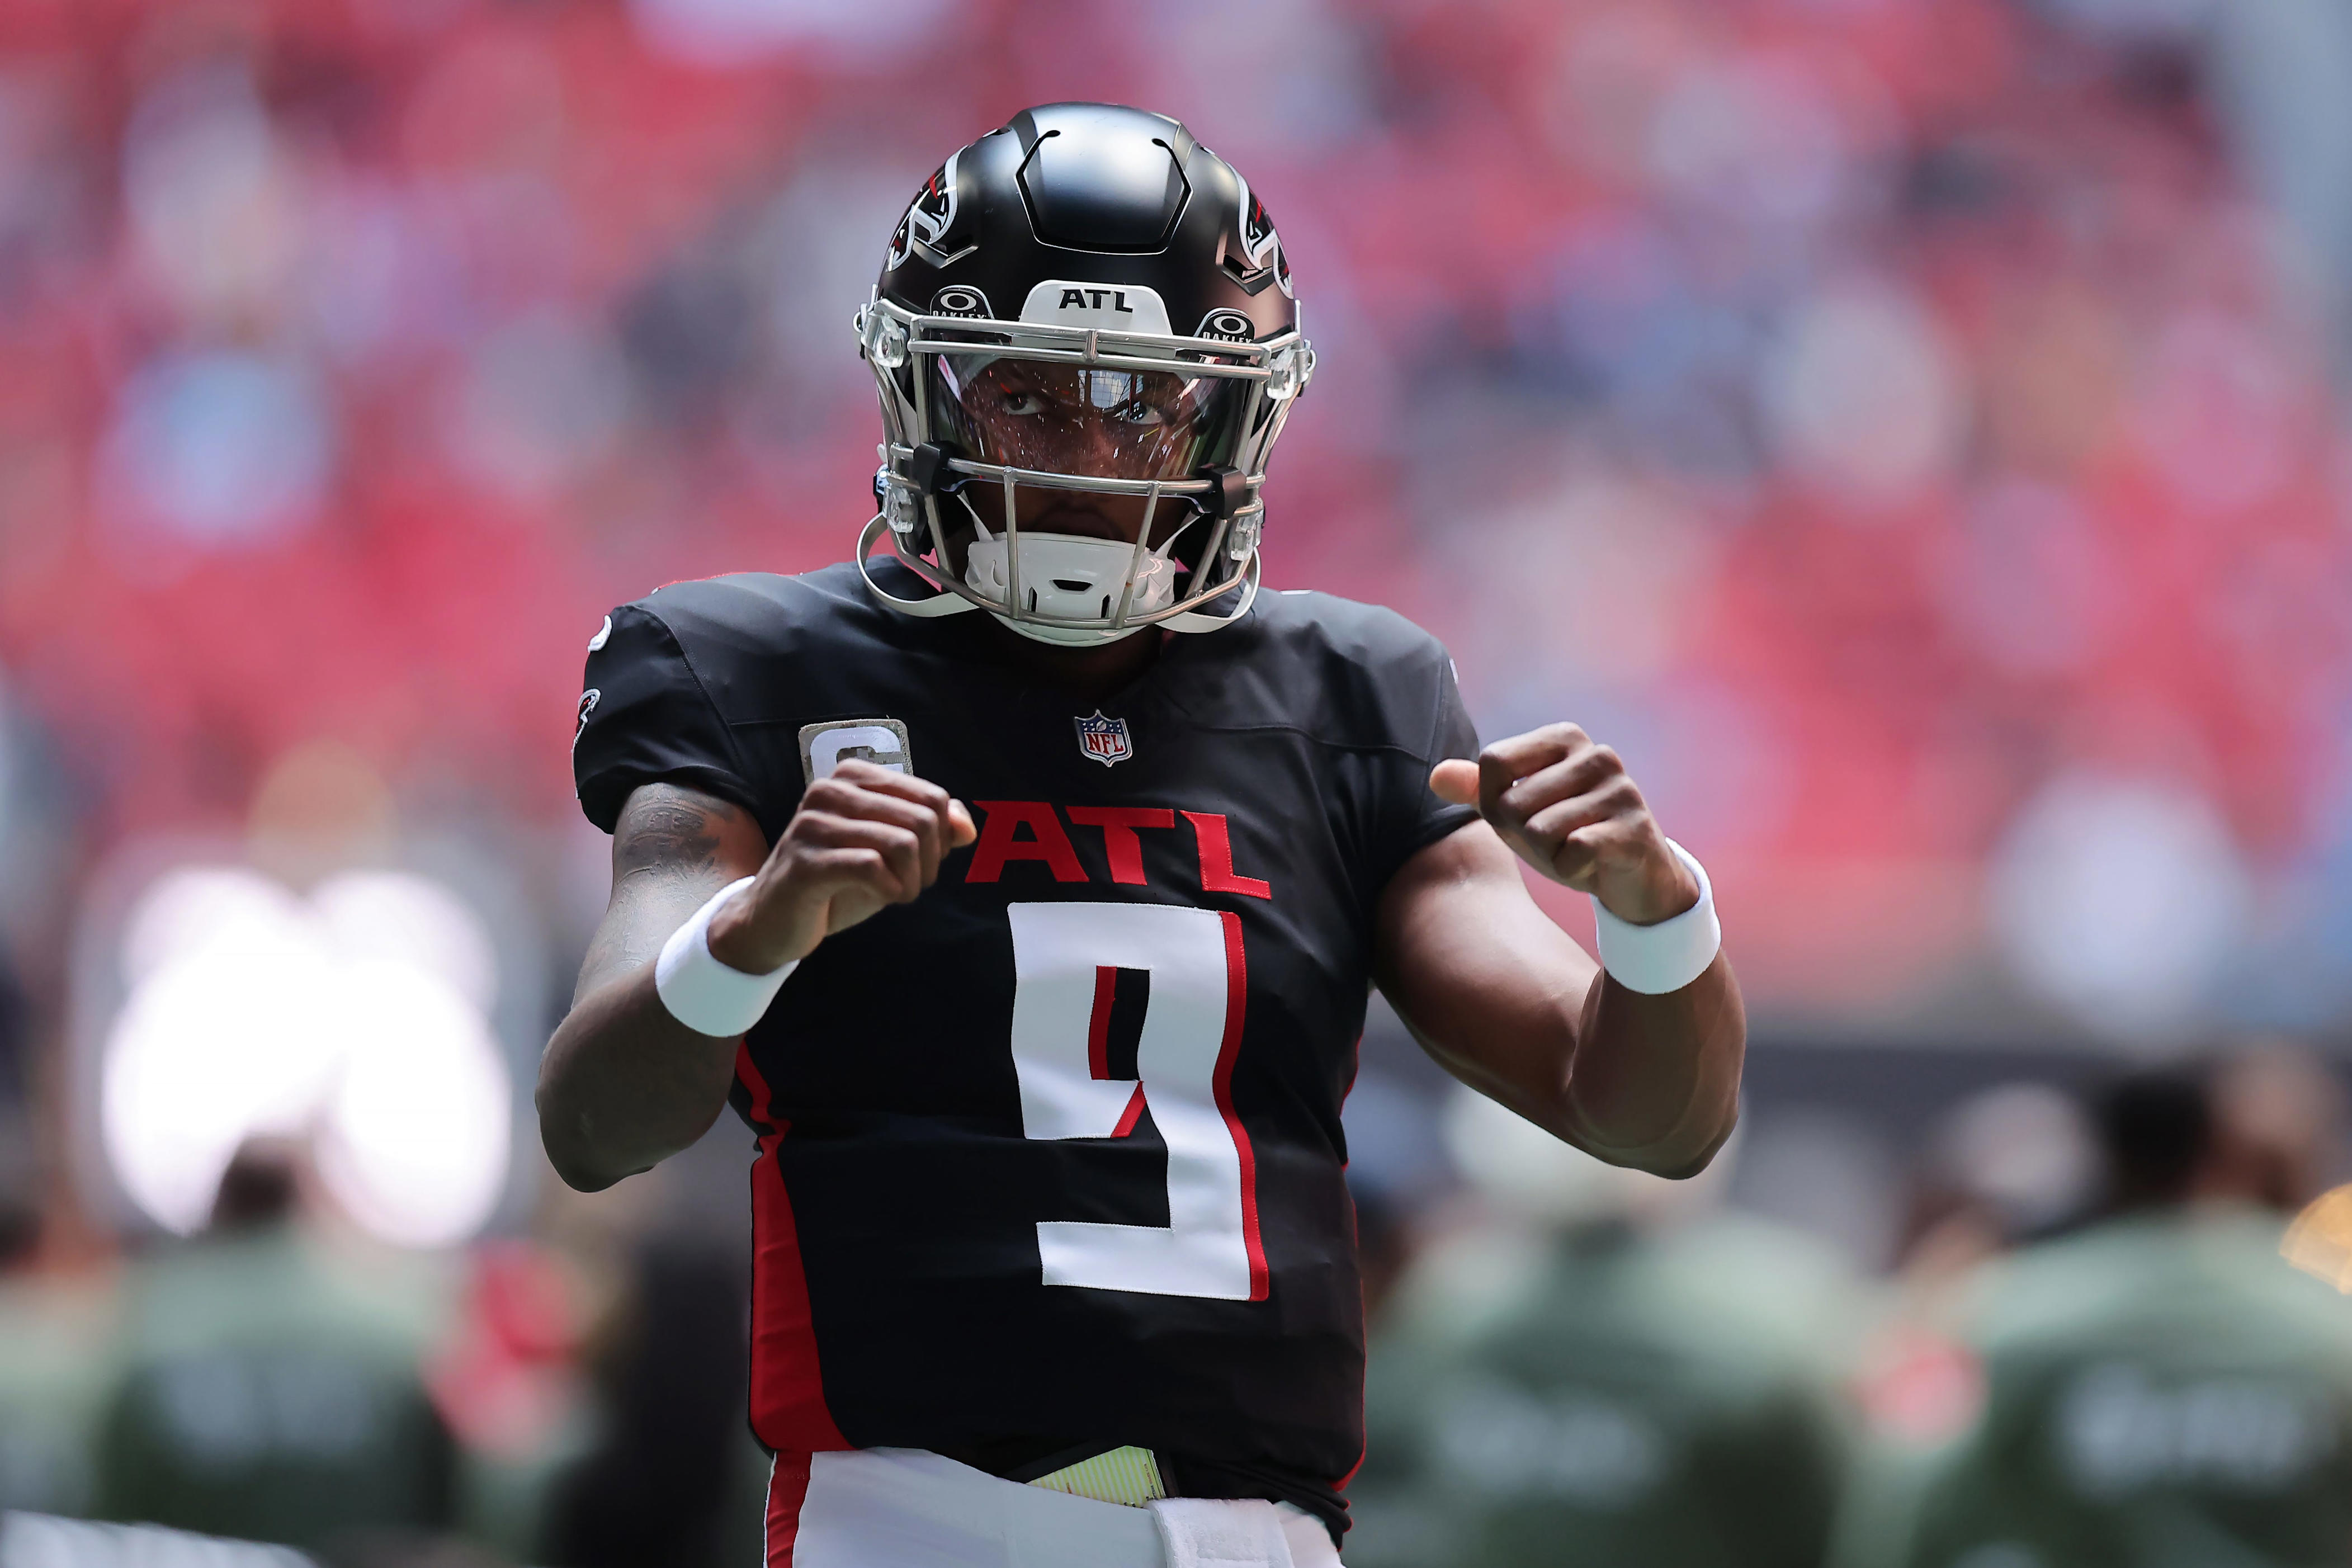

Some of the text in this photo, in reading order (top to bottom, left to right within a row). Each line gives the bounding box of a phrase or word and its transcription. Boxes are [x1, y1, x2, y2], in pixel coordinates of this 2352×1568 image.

[1059, 289, 1134, 313] ATL
[1085, 733, 1125, 755] NFL
[964, 800, 1272, 900] ATL
[1007, 901, 1270, 1302] 9
